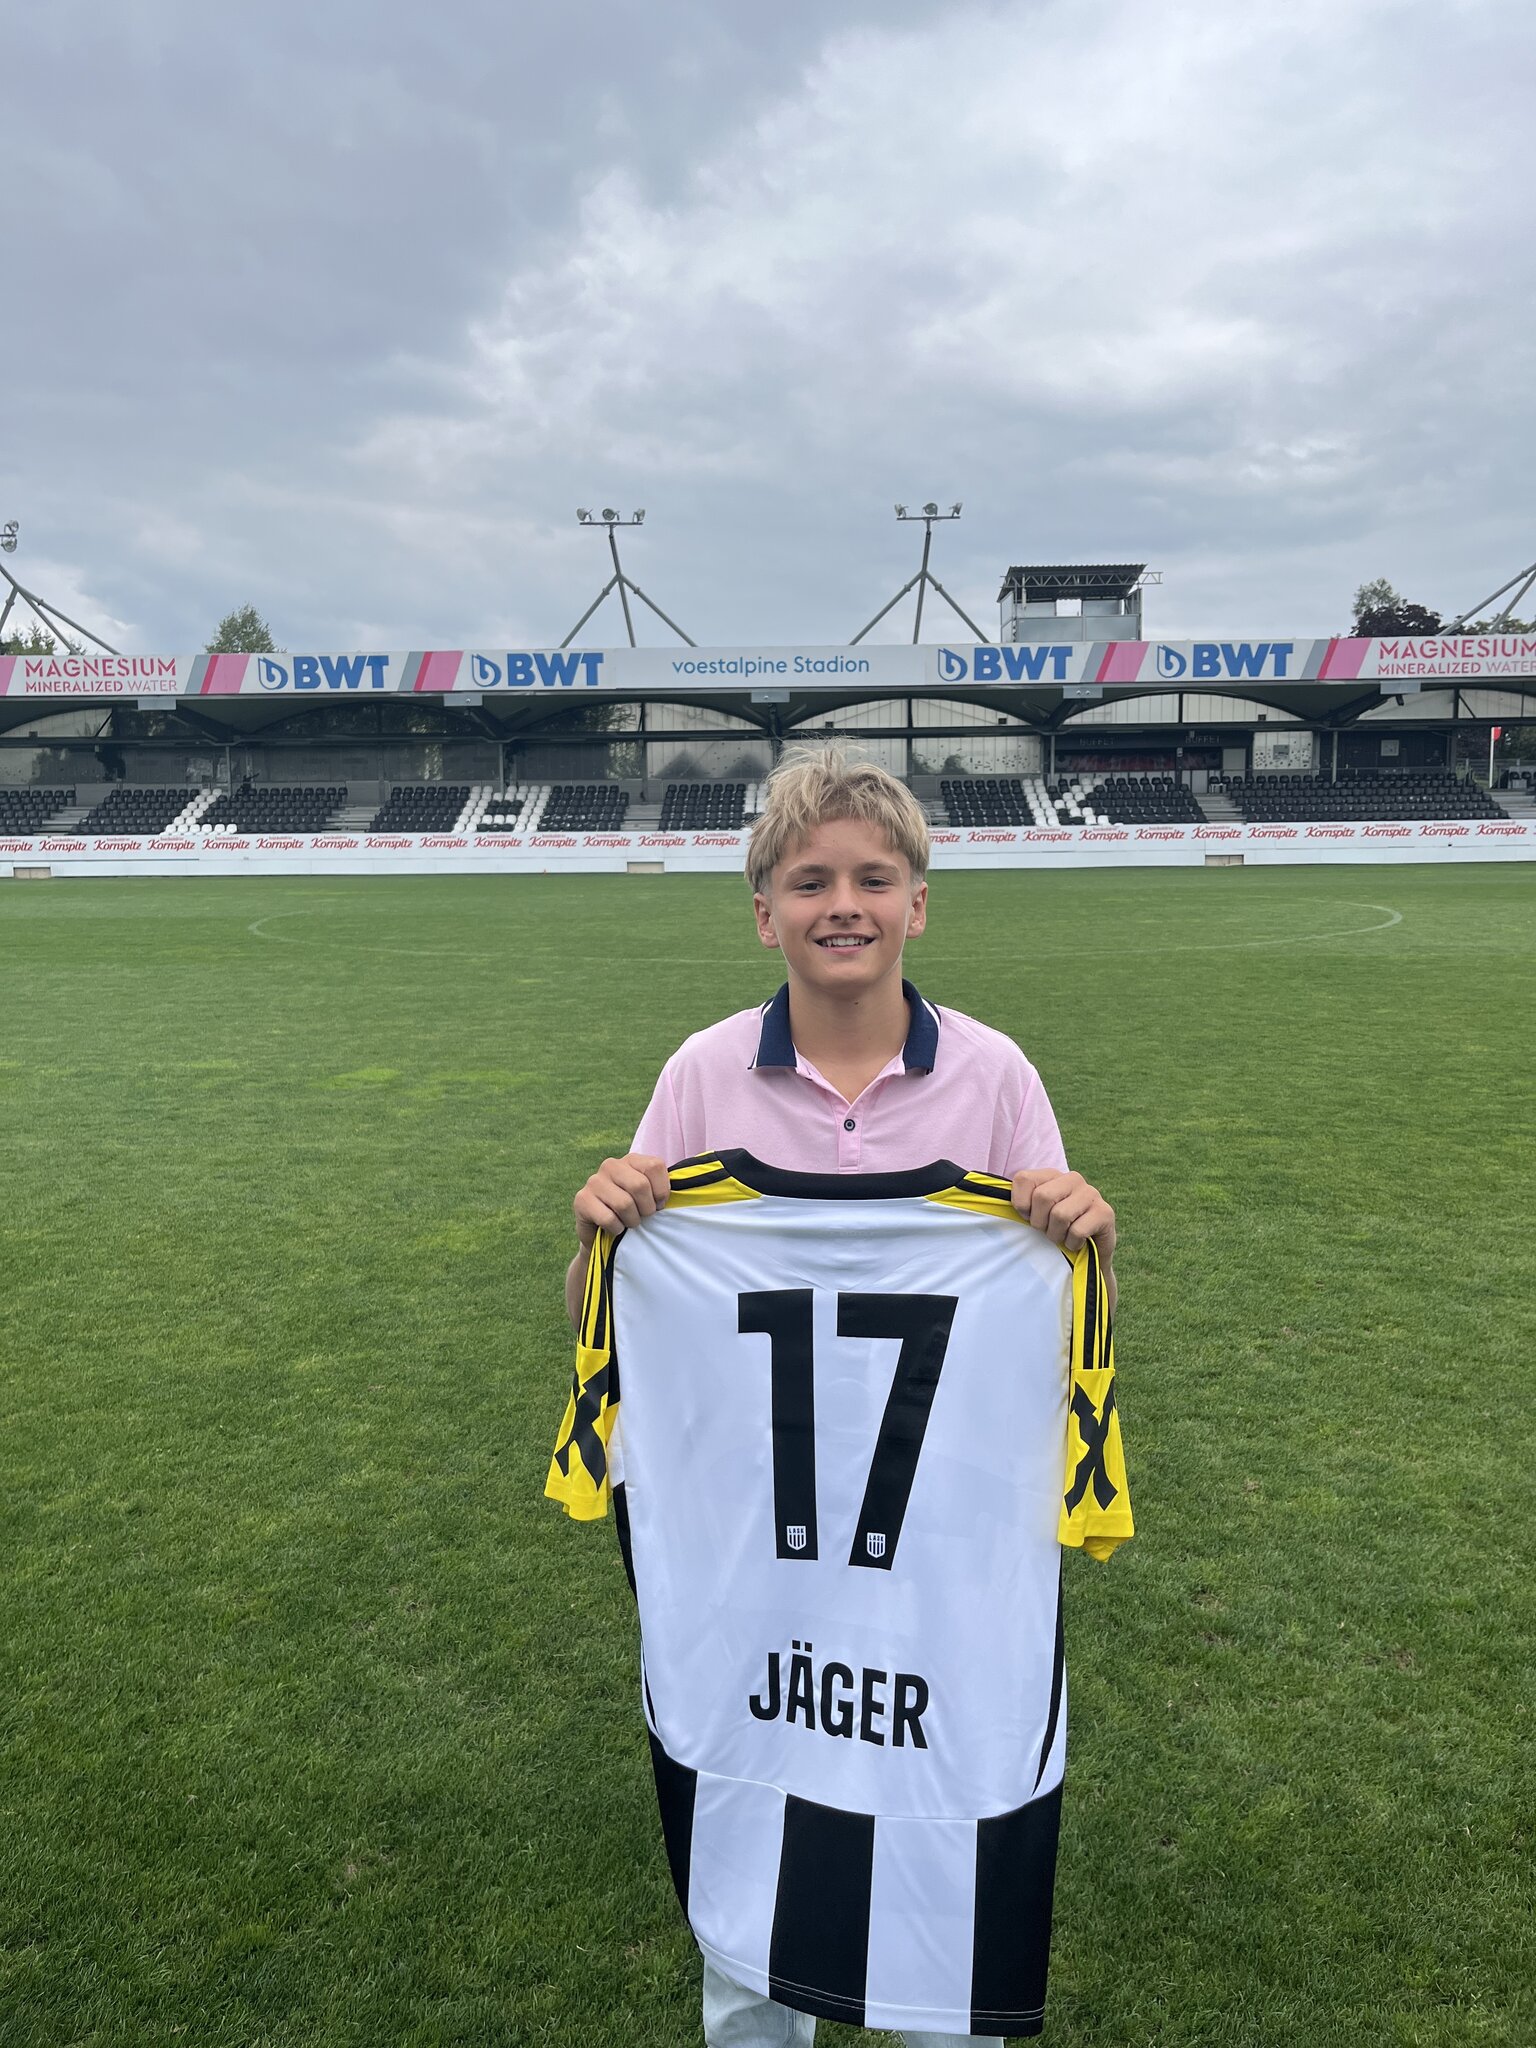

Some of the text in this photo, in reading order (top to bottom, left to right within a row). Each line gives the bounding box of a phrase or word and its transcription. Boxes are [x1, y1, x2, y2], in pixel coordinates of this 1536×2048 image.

[1379, 637, 1536, 661] MAGNESIUM
[672, 655, 870, 678] voestalpine Stadion
[974, 646, 1073, 681] BWT
[1193, 642, 1294, 678] BWT
[25, 657, 178, 678] MAGNESIUM
[293, 655, 389, 689] BWT
[506, 652, 605, 687] BWT
[1378, 660, 1536, 676] MINERALIZED WATER
[26, 679, 178, 693] MINERALIZED WATER
[1022, 830, 1073, 843] Kornspitz
[1078, 829, 1129, 842] Kornspitz
[1134, 828, 1185, 841] Kornspitz
[1191, 826, 1242, 841] Kornspitz
[1247, 827, 1298, 840] Kornspitz
[1304, 826, 1355, 839] Kornspitz
[1361, 825, 1412, 838] Kornspitz
[1418, 825, 1470, 837] Kornspitz
[1475, 824, 1527, 836] Kornspitz
[310, 837, 359, 850] Kornspitz
[365, 837, 413, 849] Kornspitz
[420, 837, 468, 849] Kornspitz
[474, 837, 522, 849] Kornspitz
[529, 836, 577, 849] Kornspitz
[583, 835, 631, 848] Kornspitz
[637, 835, 686, 848] Kornspitz
[692, 833, 740, 848] Kornspitz
[967, 831, 1017, 844] Kornspitz
[39, 840, 87, 853] Kornspitz
[93, 840, 142, 852] Kornspitz
[147, 838, 196, 852] Kornspitz
[202, 838, 250, 851] Kornspitz
[256, 838, 304, 851] Kornspitz
[737, 1287, 960, 1571] 17
[749, 1639, 930, 1750] JÄGER
